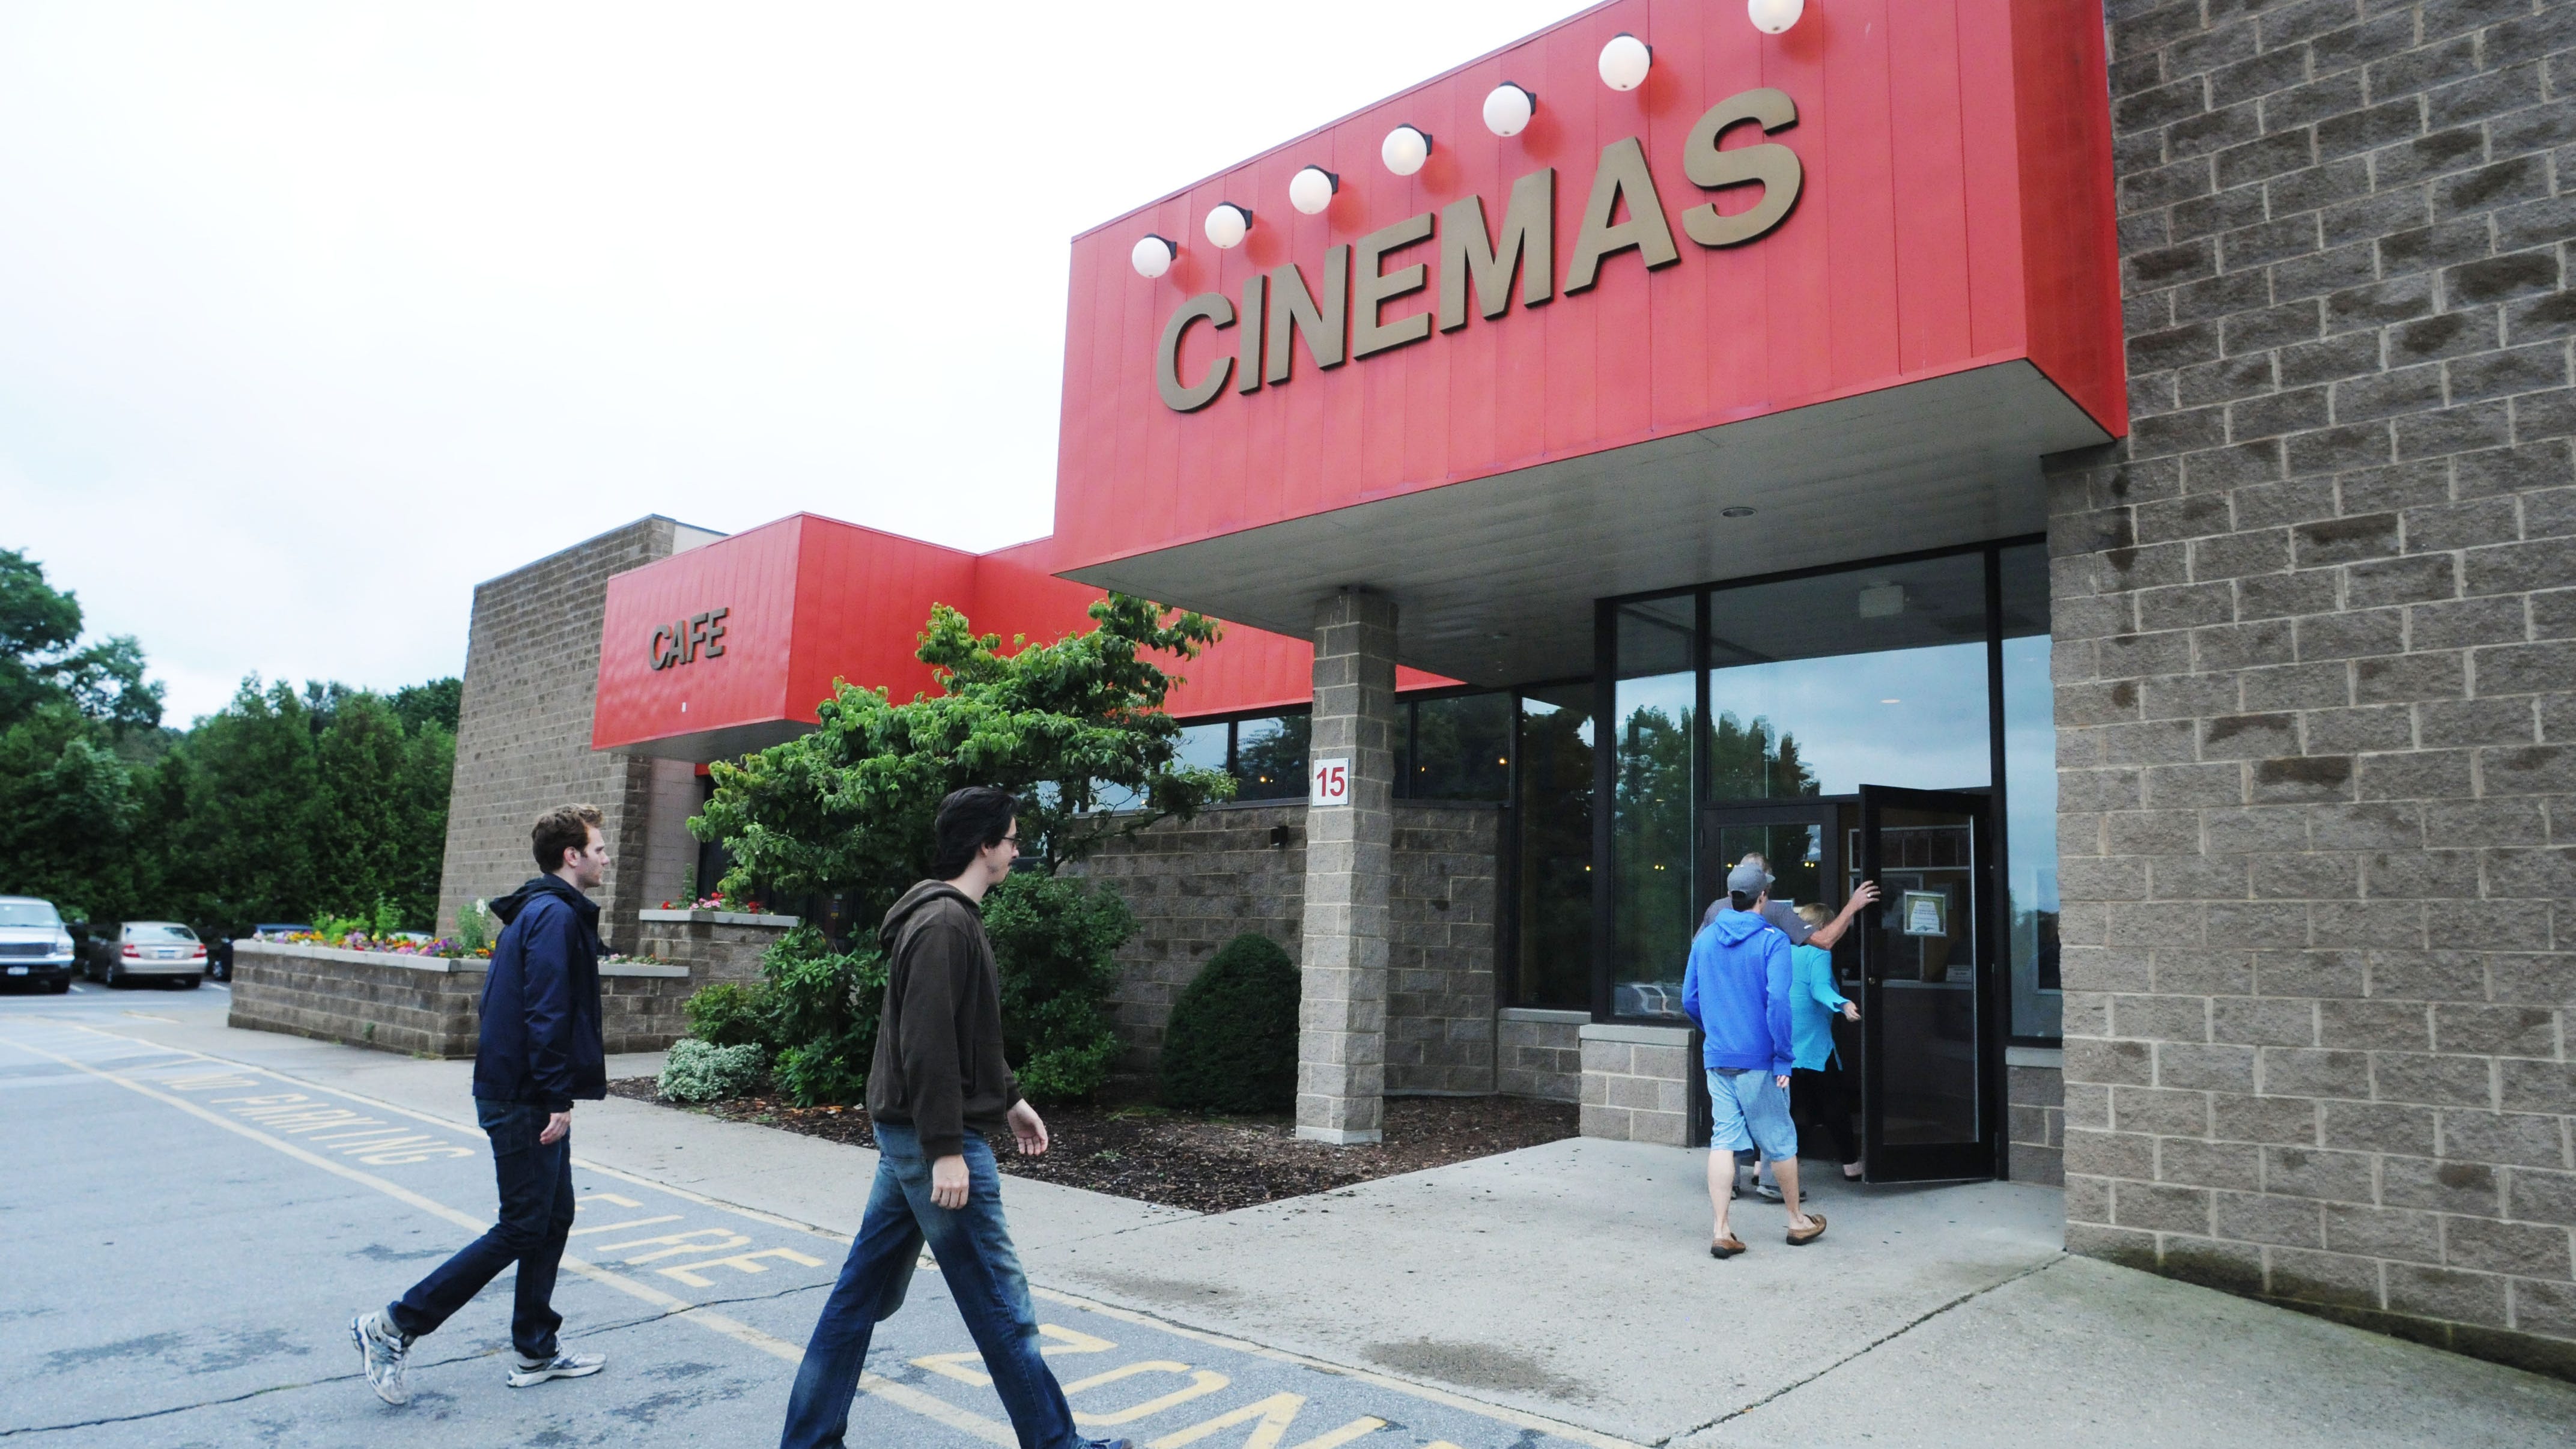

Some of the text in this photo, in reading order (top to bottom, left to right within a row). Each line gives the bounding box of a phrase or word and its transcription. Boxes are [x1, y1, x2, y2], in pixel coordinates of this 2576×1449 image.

[1156, 87, 1802, 413] CINEMAS
[649, 607, 729, 670] CAFE
[1317, 767, 1344, 797] 15
[160, 1072, 260, 1090] NO
[210, 1093, 475, 1165] PARKING
[910, 1323, 1466, 1449] ZON
